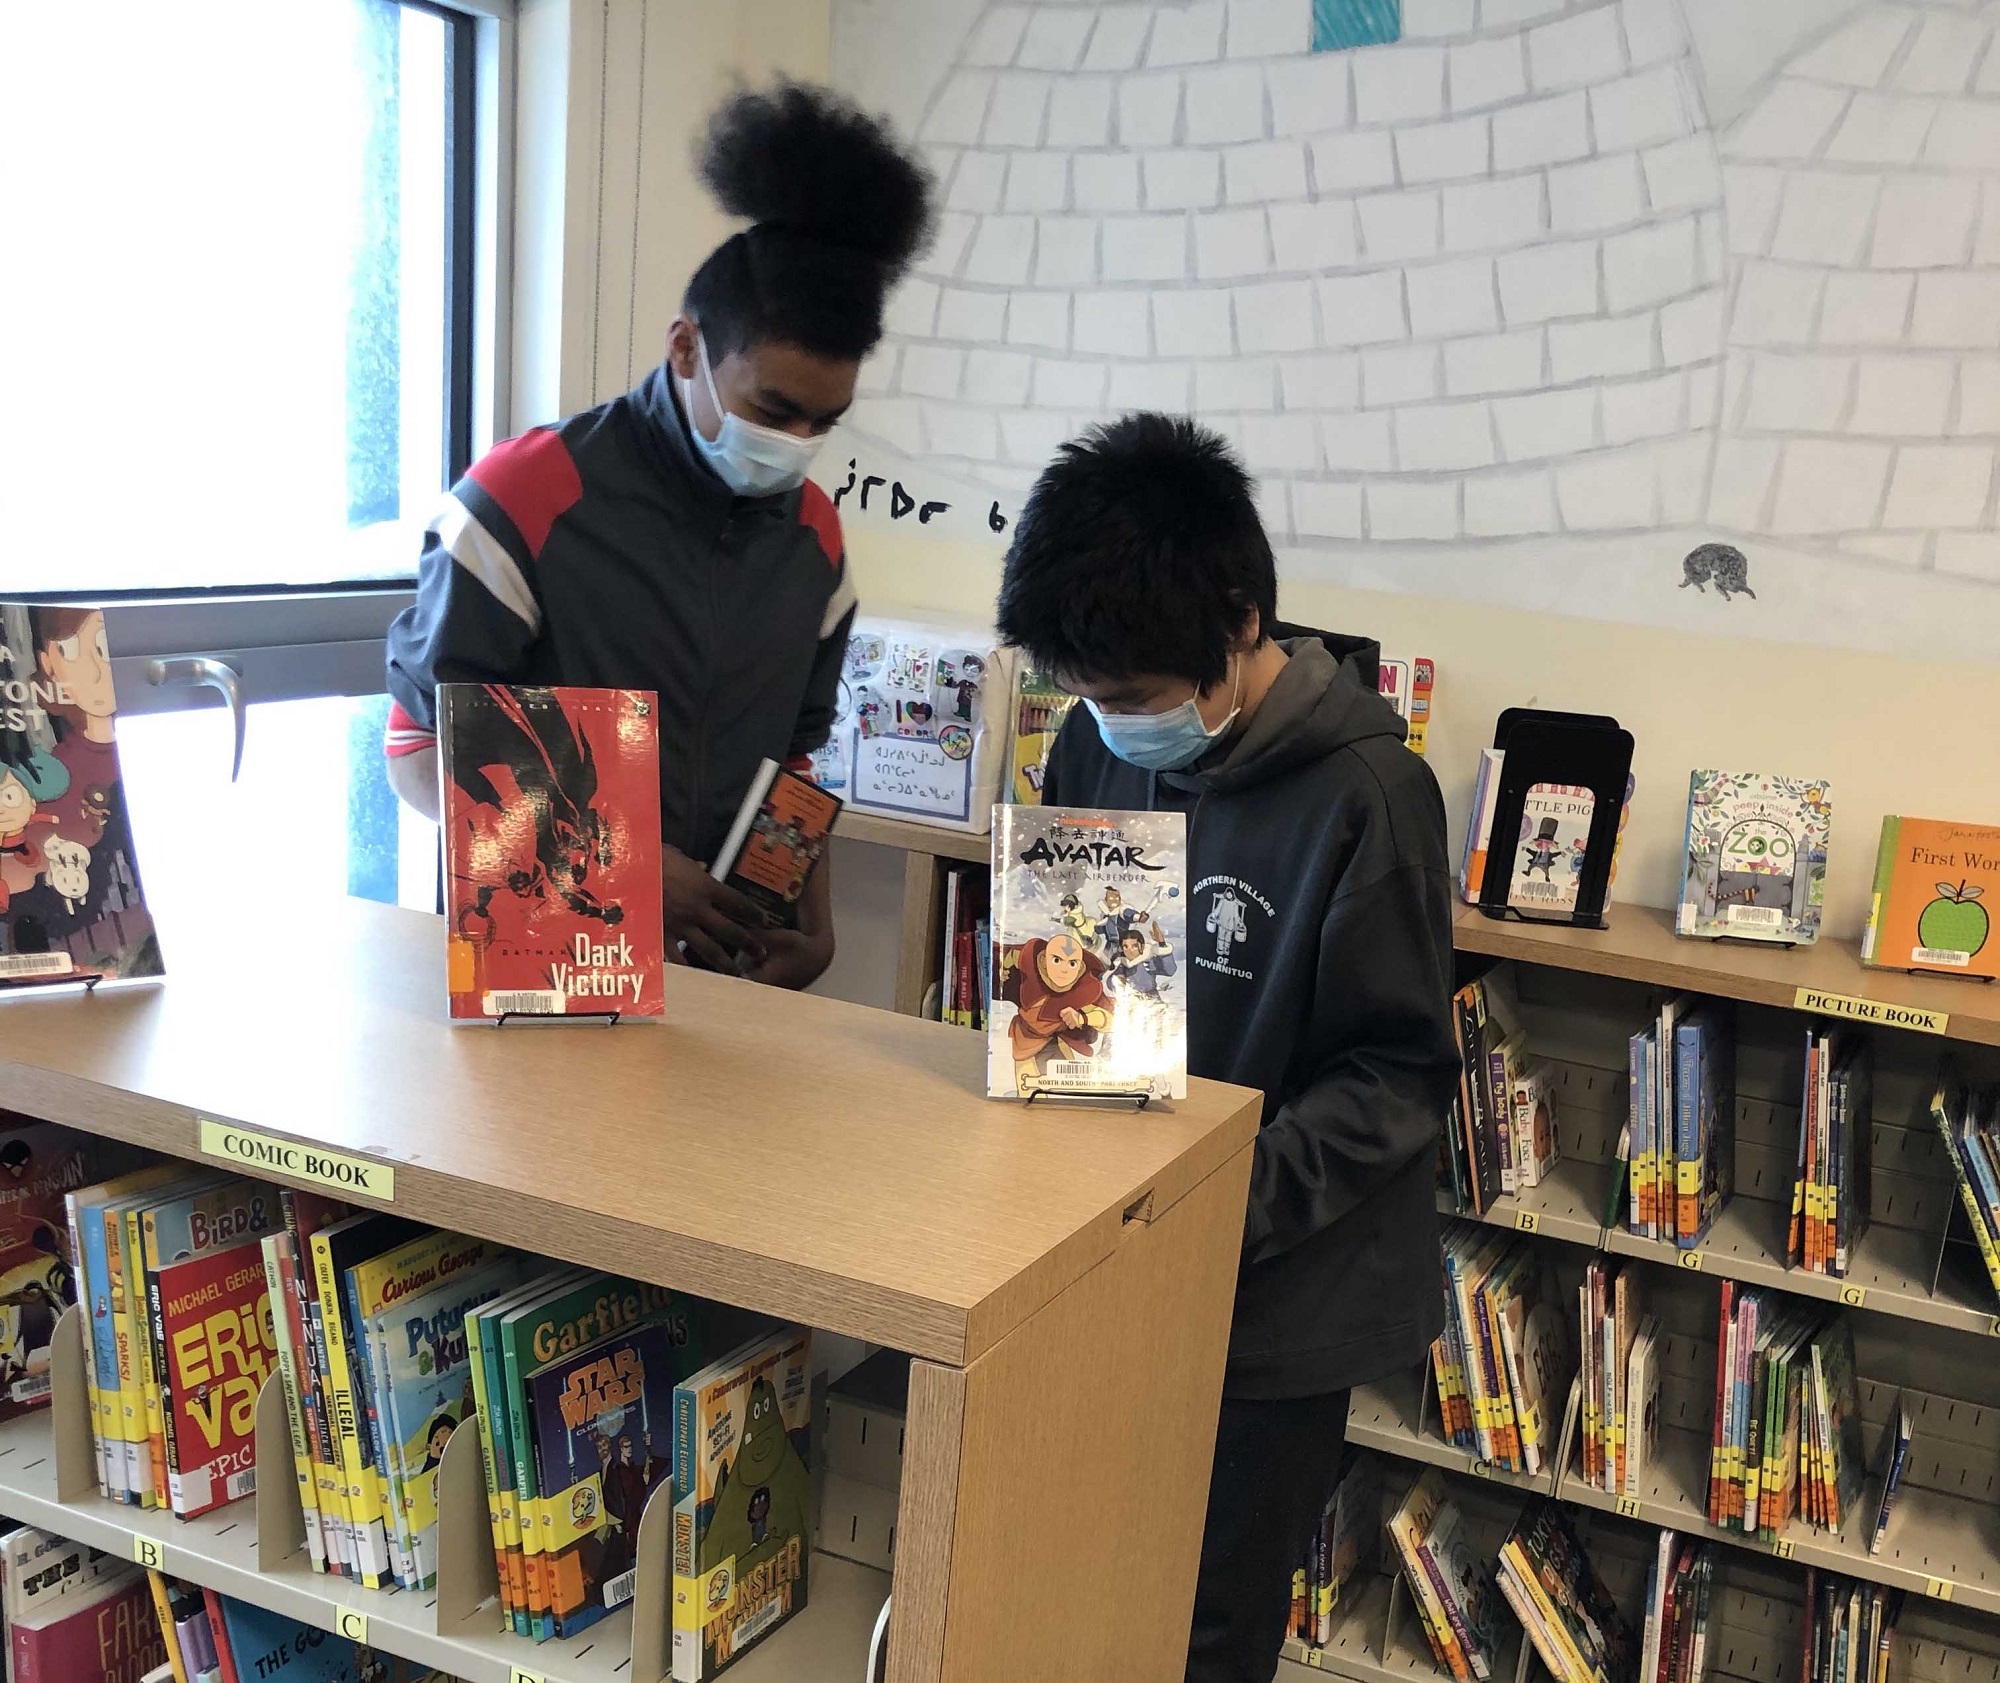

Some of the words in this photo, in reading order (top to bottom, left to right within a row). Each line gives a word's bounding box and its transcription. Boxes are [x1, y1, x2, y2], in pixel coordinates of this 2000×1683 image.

[1567, 803, 1591, 816] PIG
[1733, 801, 1760, 814] peep
[1766, 803, 1794, 819] inside
[1020, 837, 1167, 871] AVATAR
[1910, 847, 1956, 866] First
[1027, 869, 1047, 879] THE
[1053, 870, 1078, 880] LAST
[1084, 872, 1150, 883] AIRBENDER
[1193, 875, 1237, 895] NORTHERN
[1239, 880, 1276, 918] VILLAGE
[502, 948, 567, 956] BATMAN
[575, 932, 634, 967] Dark
[1217, 956, 1229, 965] OF
[1195, 956, 1253, 980] PUVIRNITUQ
[551, 963, 644, 1004] Victory
[1805, 994, 1880, 1019] PICTURE
[1885, 1005, 1938, 1029] BOOK
[1496, 1098, 1507, 1119] body
[1518, 1107, 1529, 1134] Baby
[223, 1135, 298, 1170] COMIC
[304, 1152, 371, 1188] BOOK
[1520, 1215, 1535, 1229] B
[1683, 1253, 1699, 1268] G
[382, 1267, 437, 1304] Curious
[1844, 1288, 1861, 1304] G
[168, 1281, 222, 1317] MICHAEL
[284, 1205, 297, 1237] CHUNG
[318, 1418, 329, 1445] ATTACK
[533, 1282, 673, 1363] Garfield
[116, 1332, 130, 1381] SPARKS!
[279, 1351, 290, 1373] POPPY
[316, 1335, 327, 1369] CLANTON
[319, 1263, 329, 1284] COLFER
[324, 1291, 334, 1315] DONKIN
[335, 1389, 355, 1440] ILLEGAL
[284, 1379, 294, 1395] SAM
[559, 1348, 645, 1401] STAR
[287, 1396, 296, 1411] AND
[560, 1372, 645, 1431] WARS
[165, 1411, 174, 1439] MICHAEL
[289, 1412, 298, 1428] THE
[680, 1398, 689, 1448] CHRISTOPHER
[292, 1430, 301, 1448] LEAF
[370, 1421, 380, 1452] FOLLOW
[206, 1445, 253, 1481] EPIC
[482, 1447, 495, 1494] GARFIELD
[680, 1450, 689, 1493] ELIOPOULOS
[1474, 1463, 1486, 1475] C
[1619, 1502, 1635, 1515] H
[140, 1541, 157, 1566] B
[676, 1511, 692, 1576] MONSTER
[1775, 1542, 1792, 1557] H
[1934, 1583, 1944, 1596] I
[1444, 1599, 1456, 1615] What
[342, 1614, 361, 1639] C
[254, 1646, 291, 1680] THE
[1306, 1652, 1317, 1664] F
